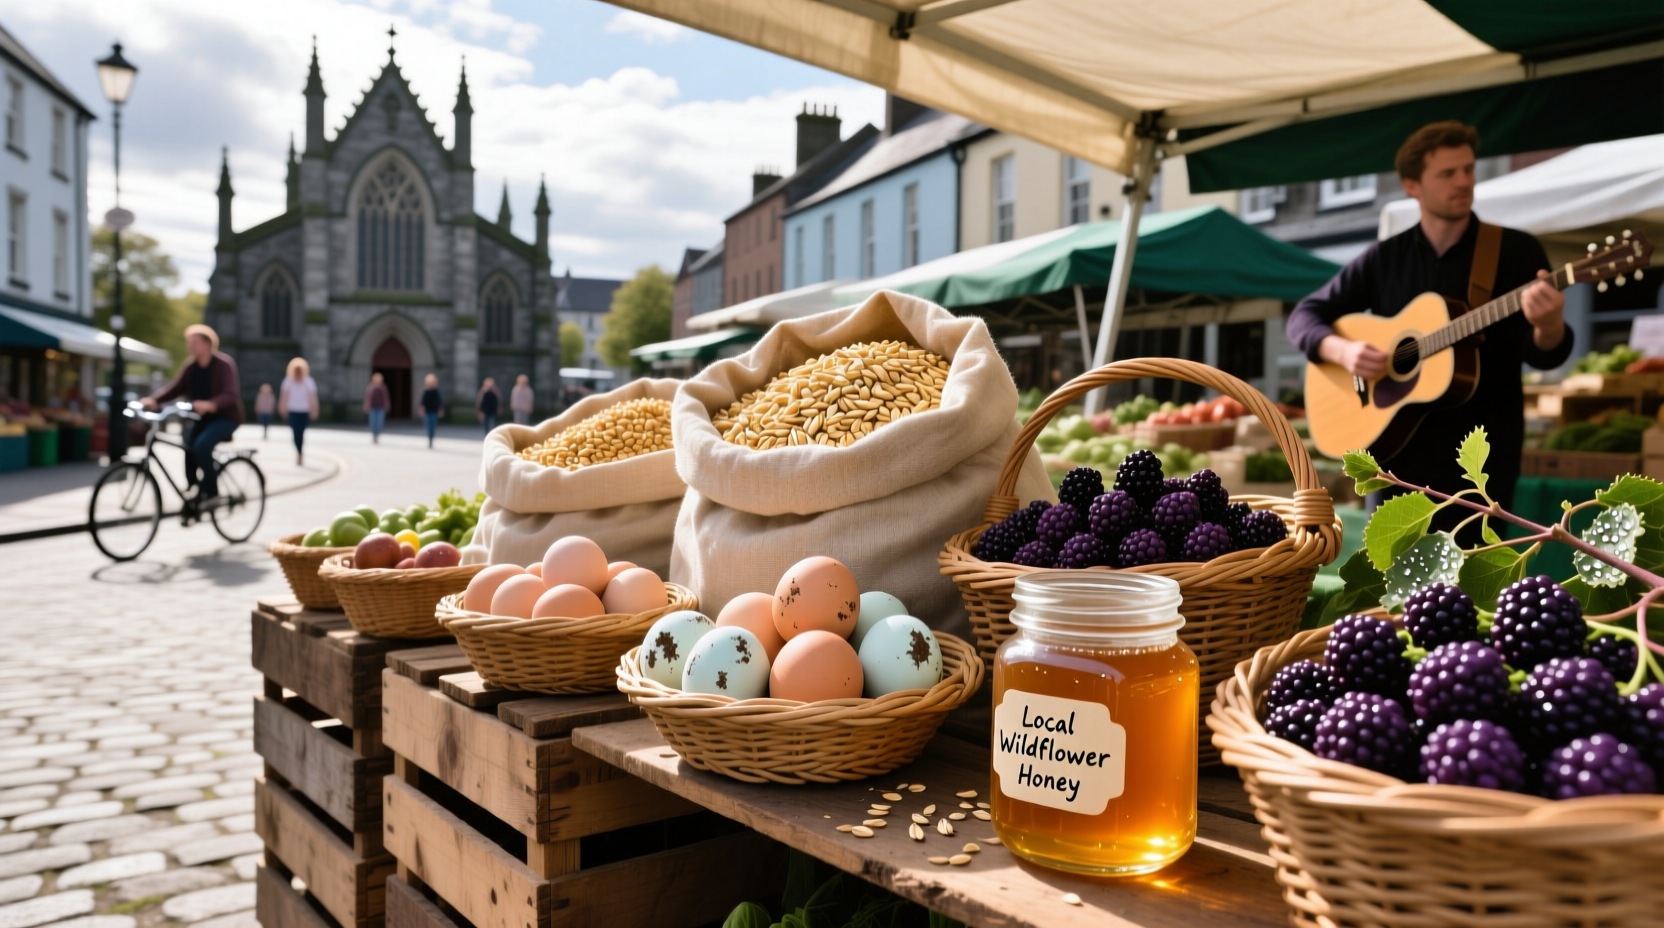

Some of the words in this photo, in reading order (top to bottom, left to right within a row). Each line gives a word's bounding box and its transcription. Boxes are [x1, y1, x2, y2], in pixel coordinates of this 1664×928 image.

[1022, 705, 1075, 735] Local
[1000, 729, 1110, 768] Wildflower
[1018, 763, 1080, 802] Honey
